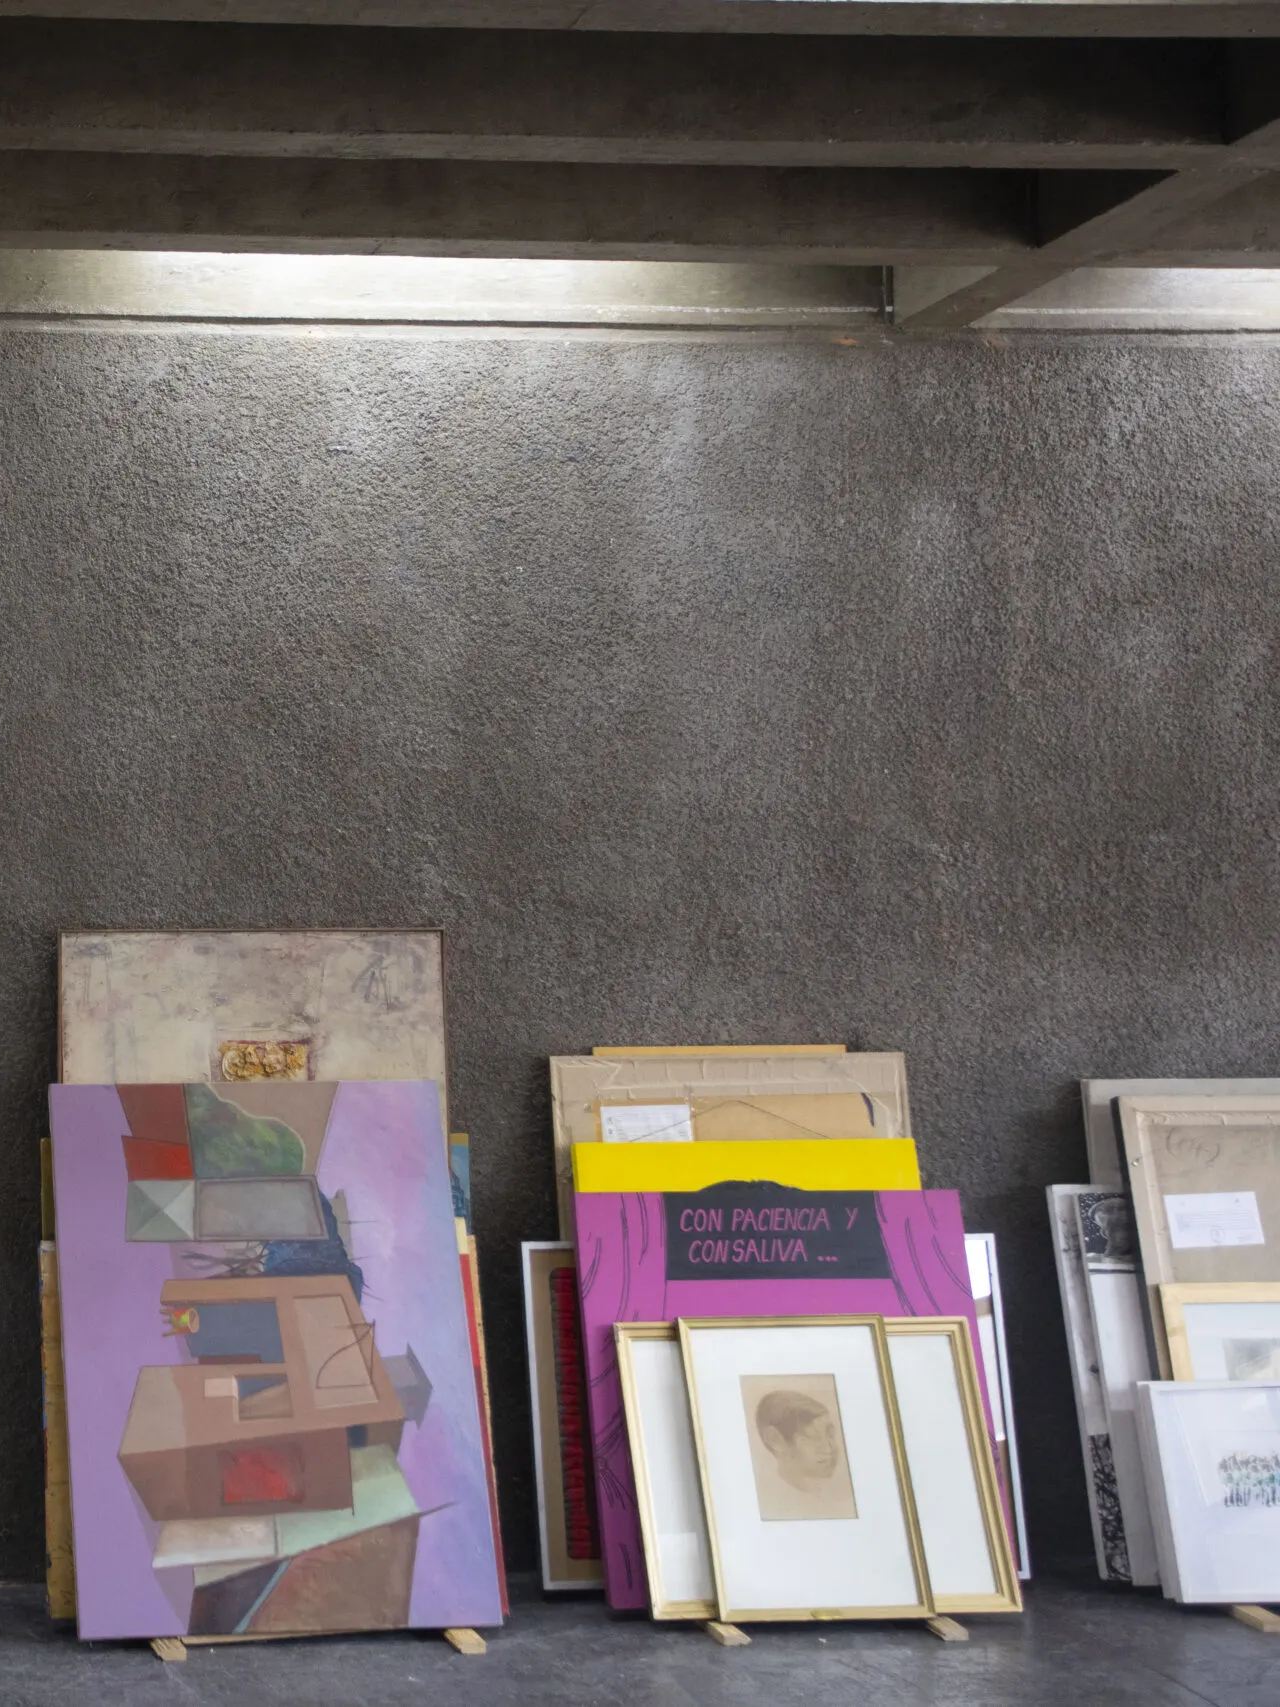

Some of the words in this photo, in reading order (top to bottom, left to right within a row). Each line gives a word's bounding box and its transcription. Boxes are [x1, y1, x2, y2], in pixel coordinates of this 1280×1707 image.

[680, 1208, 722, 1232] CON
[731, 1207, 831, 1232] PACIENCIA
[845, 1207, 858, 1231] Y
